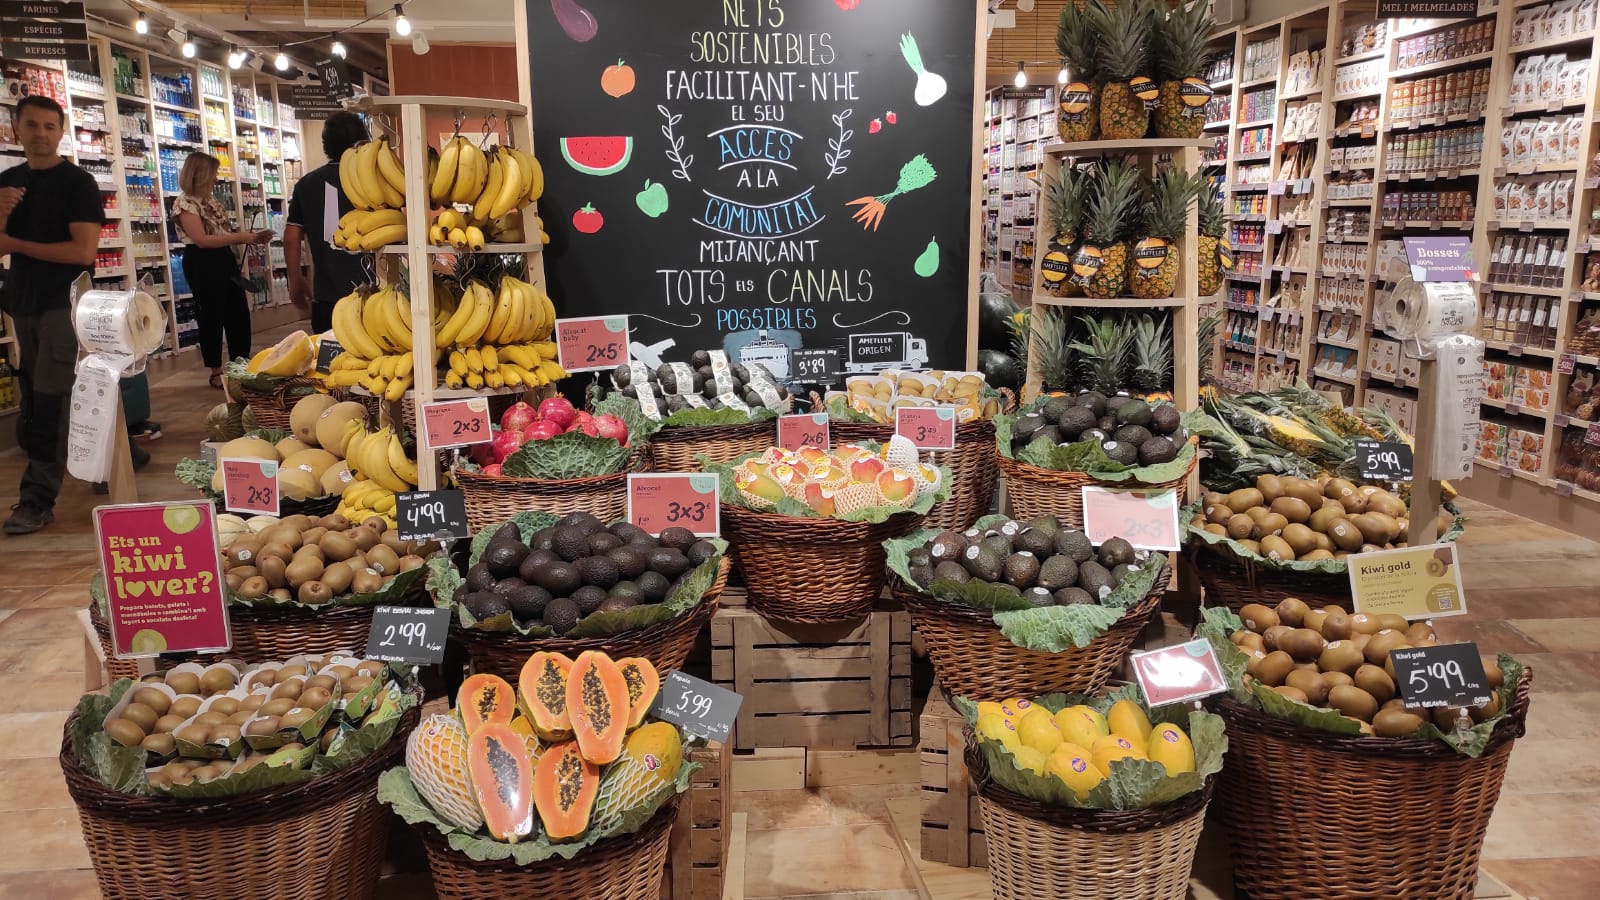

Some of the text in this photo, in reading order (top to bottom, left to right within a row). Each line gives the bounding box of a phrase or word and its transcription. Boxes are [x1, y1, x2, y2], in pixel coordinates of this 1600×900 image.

[23, 5, 59, 14] FARINES
[1382, 3, 1474, 12] MEL I MELMELADES
[25, 47, 67, 55] REFRESCS
[690, 31, 836, 66] SOSTENIBLES
[731, 104, 785, 122] EL SEU
[737, 168, 779, 188] A LA
[704, 192, 818, 235] COMUNITAT
[699, 239, 820, 266] MIJANÇANT
[1416, 247, 1460, 258] Bosses
[655, 268, 873, 307] TOTS ELS CANALS
[716, 307, 817, 331] POSSIBLES
[858, 346, 892, 356] ORIGEN
[406, 501, 446, 527] 4'99
[108, 536, 161, 549] Ets un
[110, 545, 187, 574] kiwi
[1360, 560, 1411, 575] Kiwi gold
[378, 622, 427, 647] 2'99
[1411, 651, 1427, 660] gold
[1408, 659, 1466, 694] 5'99
[676, 690, 713, 719] 5.99
